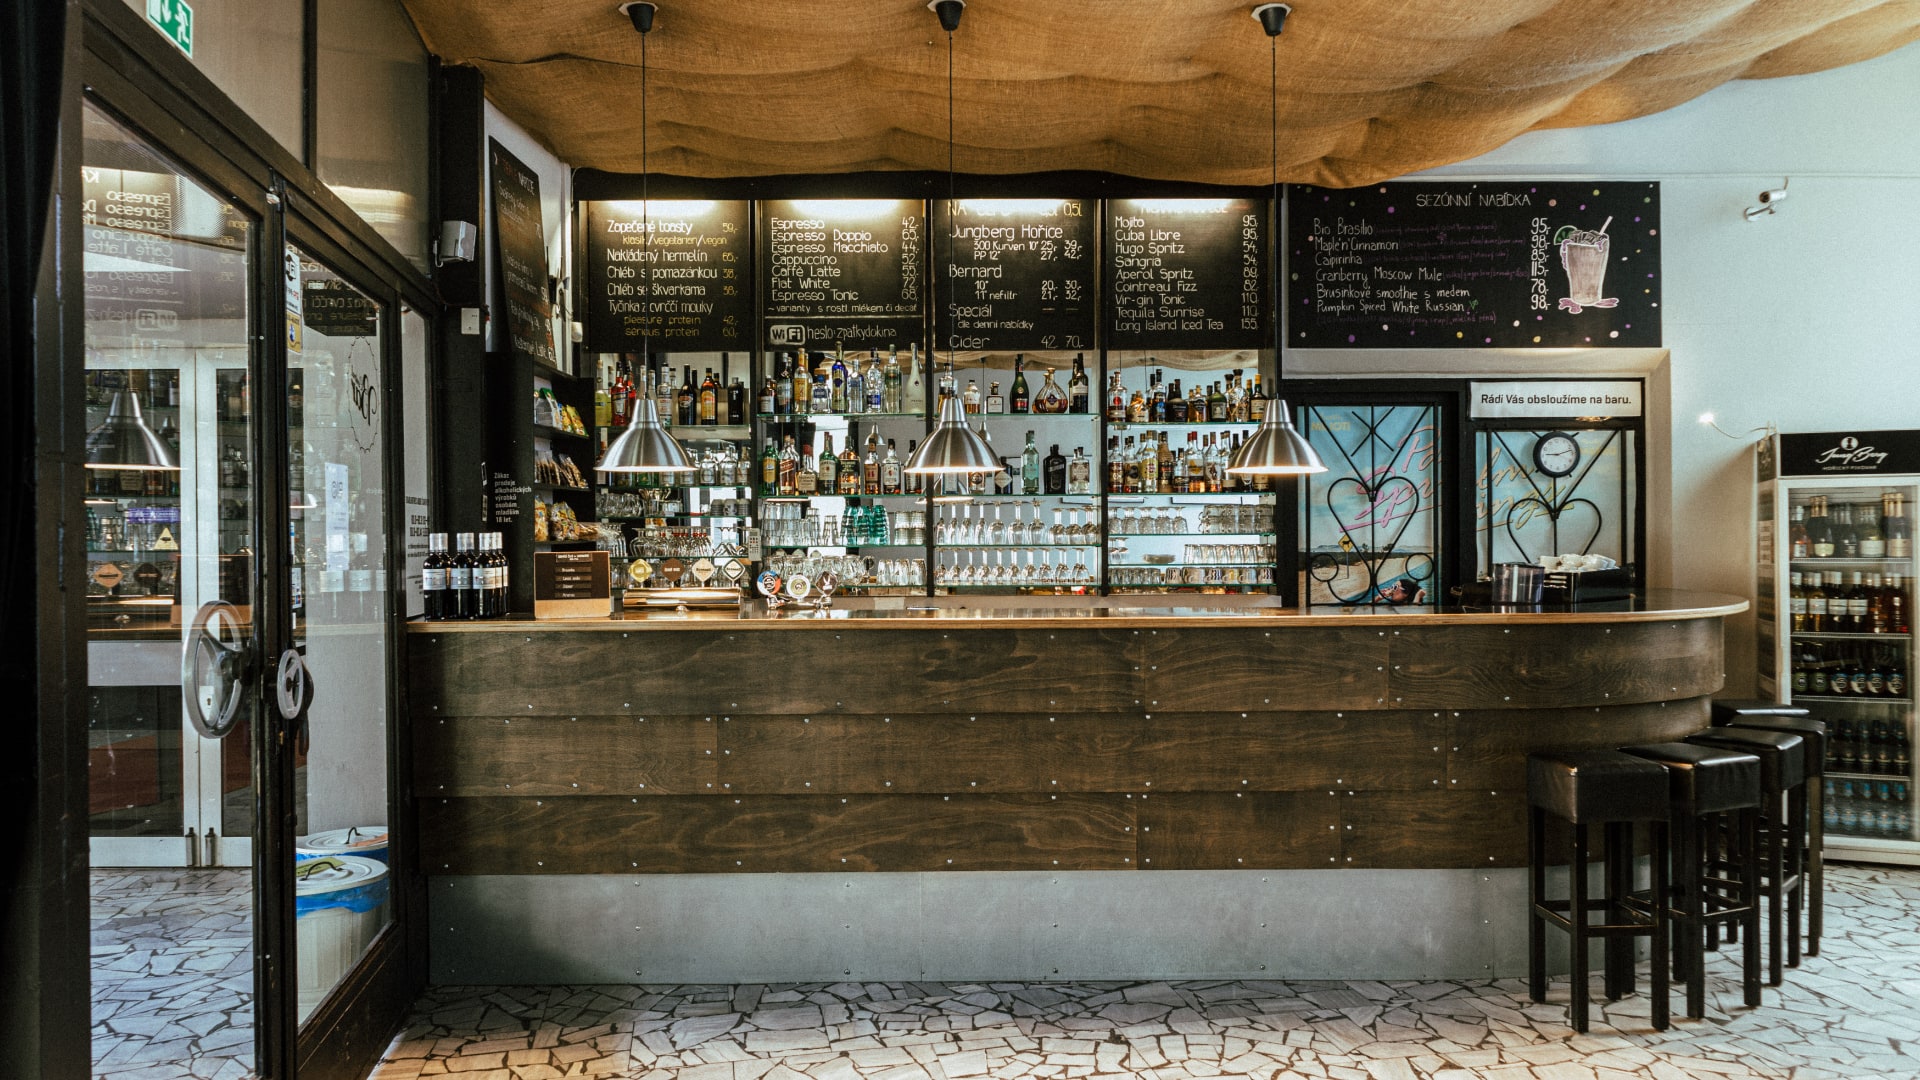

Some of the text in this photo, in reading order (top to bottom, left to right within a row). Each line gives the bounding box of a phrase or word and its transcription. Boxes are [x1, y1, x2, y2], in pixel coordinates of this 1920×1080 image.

[1416, 191, 1532, 207] SEZÓNNÍ NABÍDKA
[658, 219, 693, 235] toasty
[771, 217, 825, 231] Espresso
[1114, 216, 1145, 231] Mojito
[1313, 217, 1331, 235] Bio
[771, 229, 826, 242] Espresso
[833, 229, 871, 242] Doppio
[948, 224, 1064, 241] Jungberg Hořice
[1114, 229, 1145, 241] Cuba
[1150, 229, 1181, 241] Libre
[771, 242, 826, 255] Espresso
[833, 241, 888, 253] Macchiato
[973, 240, 991, 251] 300
[992, 240, 1026, 251] Kurven
[1115, 242, 1144, 256] Hugo
[1148, 242, 1185, 256] Spritz
[607, 248, 659, 263] Nakládaný
[662, 249, 708, 262] hermelín
[771, 253, 837, 266] Cappuccino
[973, 250, 987, 260] PP
[1314, 251, 1363, 268] Caipirinha
[1114, 255, 1162, 270] Sangria
[607, 265, 718, 281] Chléb s pomazánkou
[810, 266, 841, 277] Latte
[948, 264, 1002, 279] Bernard
[1115, 268, 1154, 282] Aperol
[1159, 267, 1195, 282] Spritz
[1315, 267, 1369, 289] Cranberry
[1373, 266, 1413, 281] Moscow
[1418, 267, 1443, 281] Mule
[607, 282, 634, 296] Chléb
[637, 285, 648, 296] se
[771, 277, 792, 289] Flat
[799, 277, 830, 289] White
[1115, 281, 1171, 292] Cointreau
[1177, 280, 1198, 292] Fizz
[771, 289, 825, 302] Espresso
[830, 289, 859, 301] Tonic
[989, 290, 1018, 300] nefiltr
[1316, 283, 1372, 299] Brusinkové
[1376, 286, 1418, 300] smoothie
[1424, 290, 1431, 299] s
[1436, 284, 1471, 298] medem
[1159, 293, 1186, 305] Tonic
[680, 301, 714, 315] mouky
[776, 304, 811, 313] varianty
[851, 303, 884, 313] mlékem
[885, 303, 893, 312] či
[948, 303, 993, 320] Speciál
[1115, 307, 1155, 320] Tequila
[1159, 306, 1205, 317] Sunrise
[1316, 300, 1355, 316] Pumpkin
[1359, 300, 1386, 315] Spiced
[1392, 300, 1420, 314] White
[1425, 300, 1465, 312] Russian
[668, 315, 702, 327] protein
[957, 320, 1034, 331] dle denní nabídky
[1115, 318, 1224, 333] Long Island Iced Tea
[665, 327, 700, 338] protein
[949, 334, 991, 349] Cider
[1481, 394, 1632, 404] Rádi Vás obsloužíme na baru.
